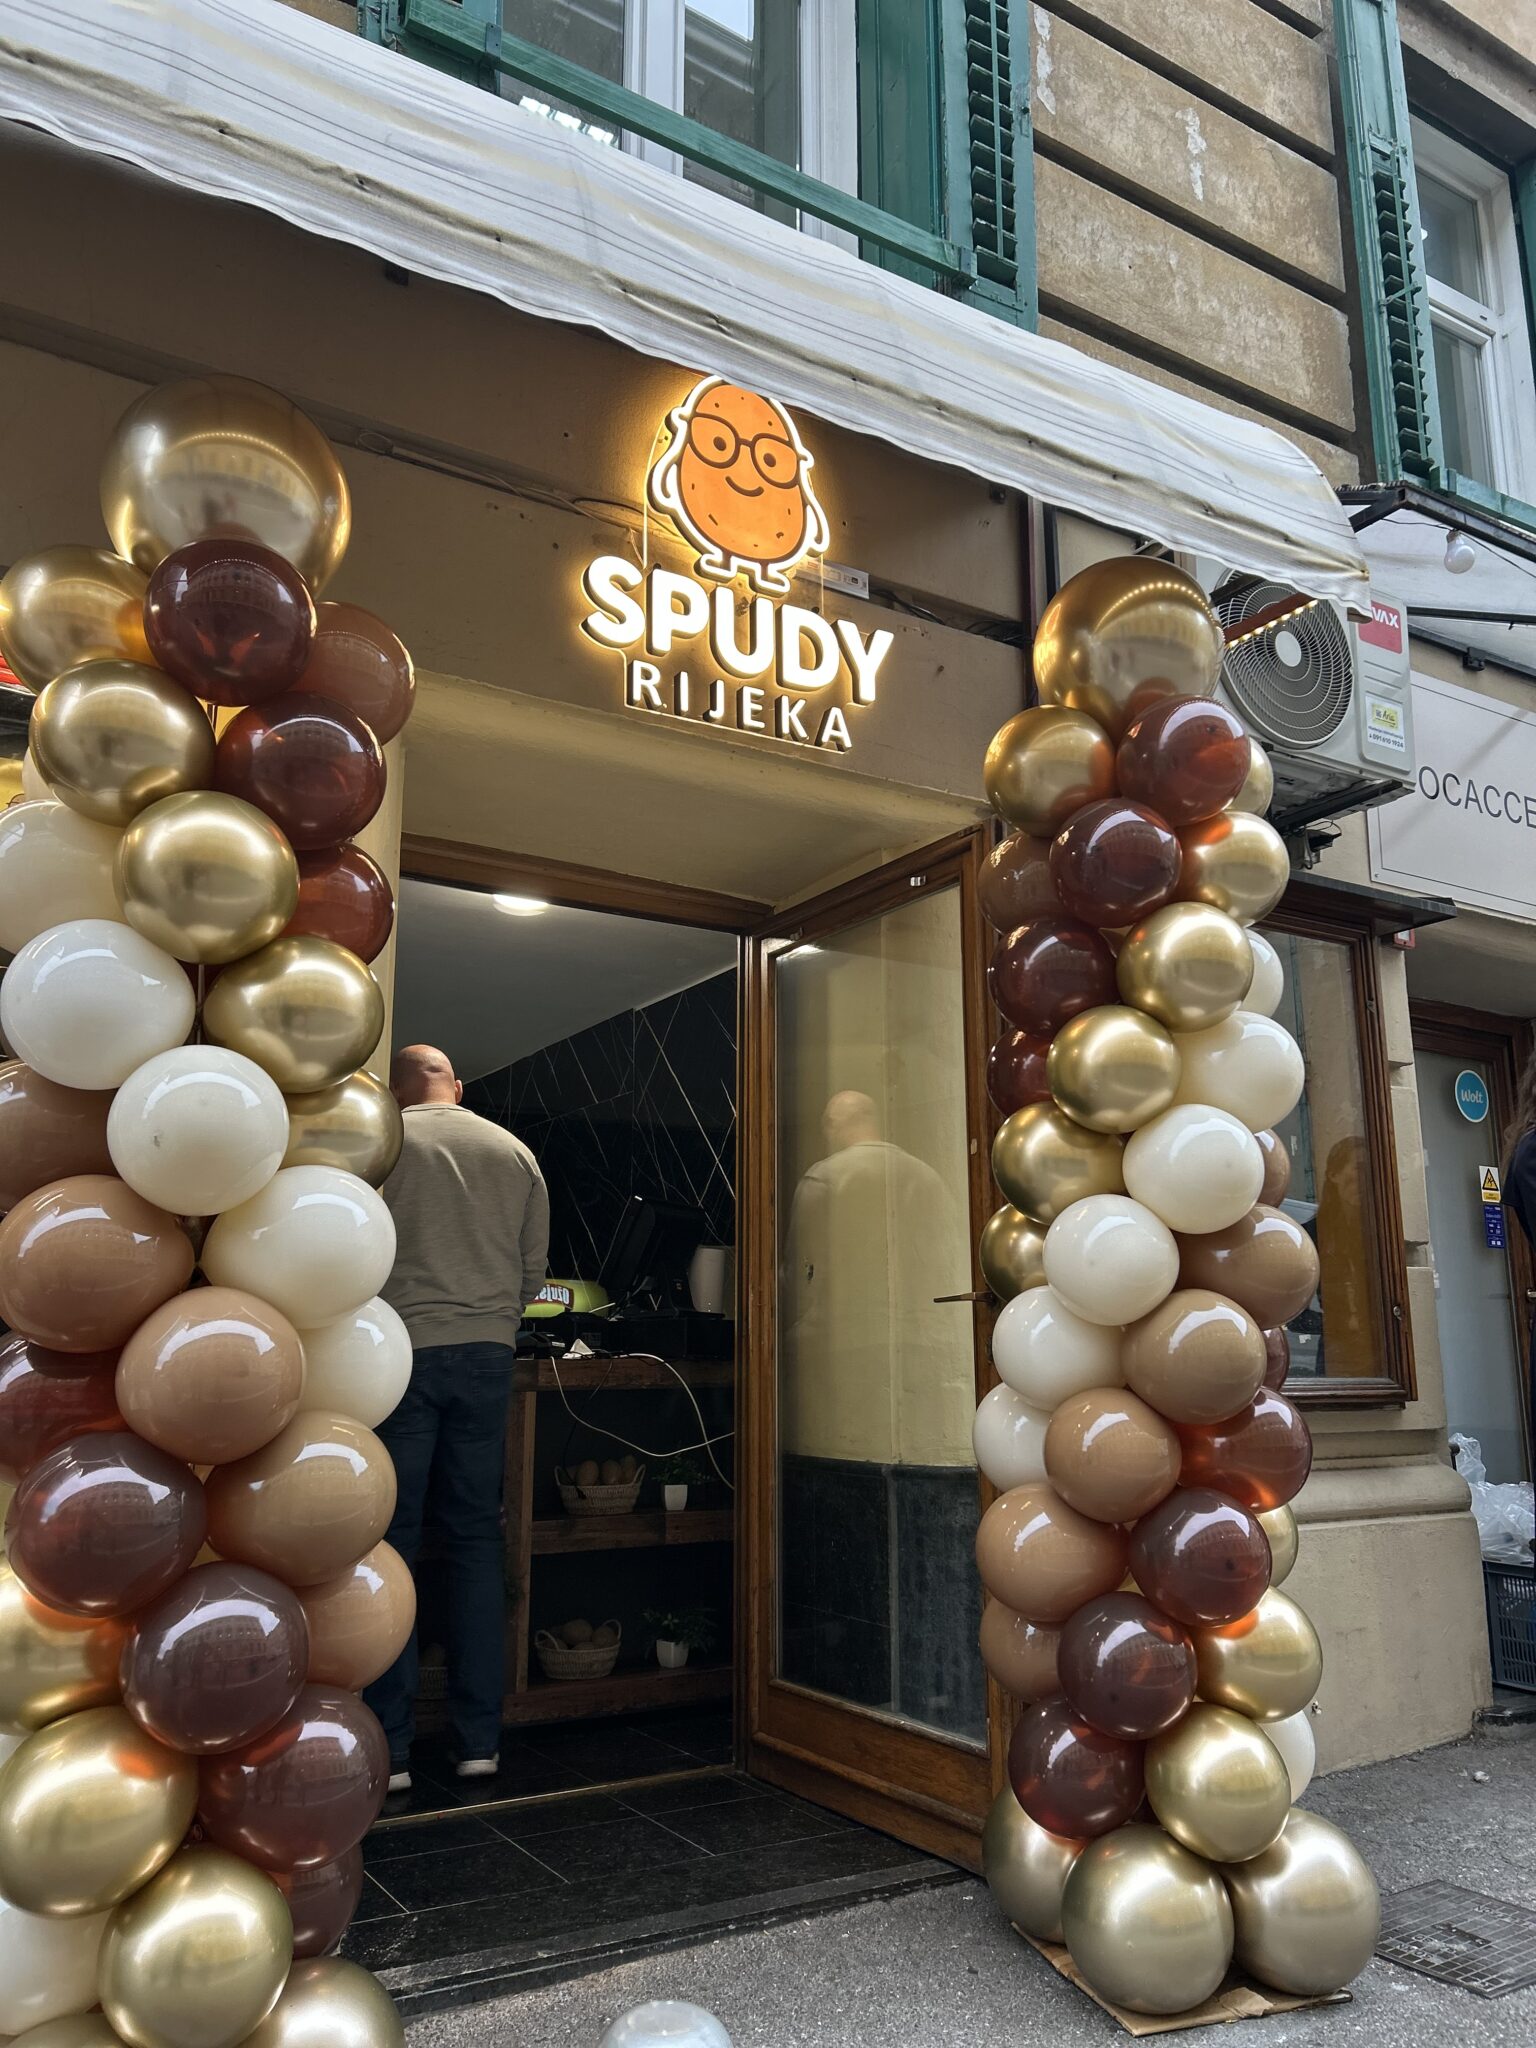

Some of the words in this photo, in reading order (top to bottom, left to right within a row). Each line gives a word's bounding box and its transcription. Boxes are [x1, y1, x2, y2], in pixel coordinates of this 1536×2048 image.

[581, 555, 895, 704] SPUDY
[627, 659, 852, 750] RIJEKA
[1461, 1089, 1484, 1104] Wolt
